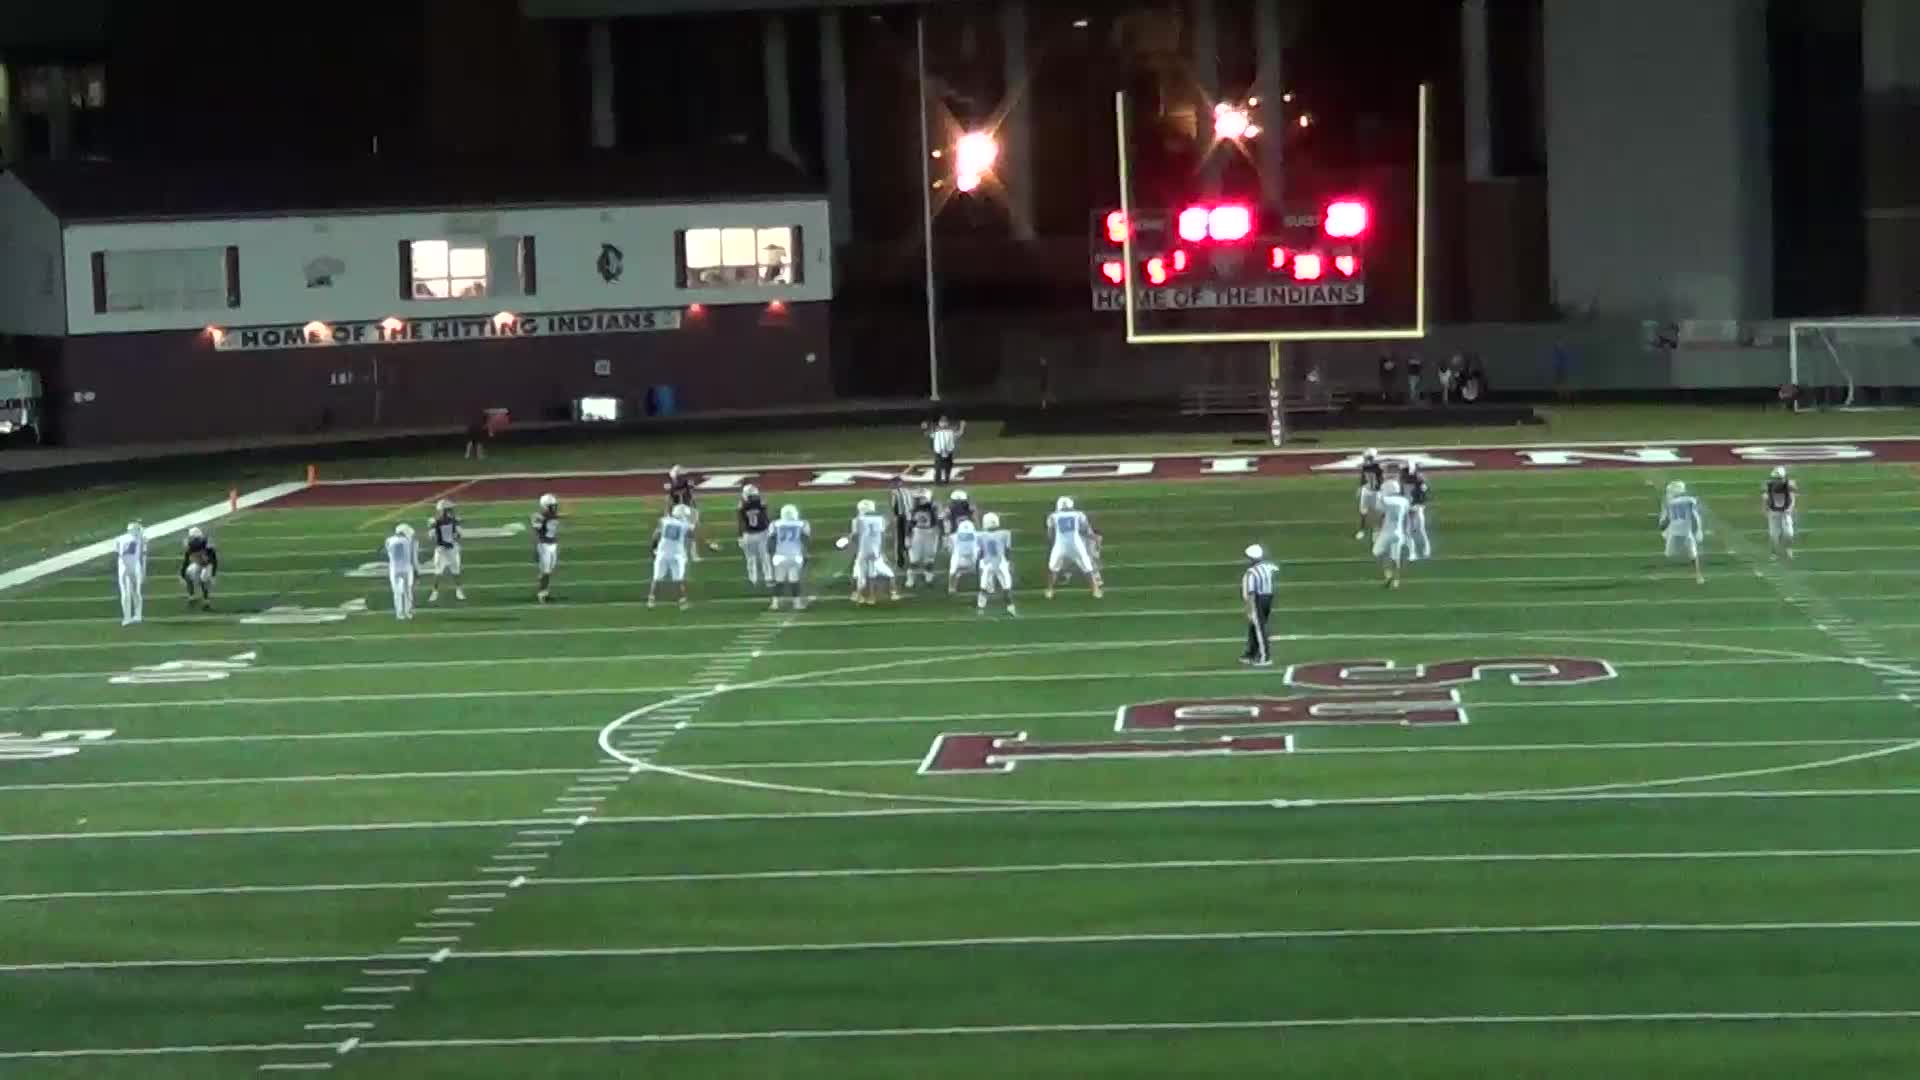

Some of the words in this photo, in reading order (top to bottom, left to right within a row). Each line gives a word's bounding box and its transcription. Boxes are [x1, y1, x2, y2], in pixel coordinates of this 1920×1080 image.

[1263, 286, 1359, 304] INDIANS
[241, 327, 322, 347] HOME
[333, 325, 365, 342] OF
[431, 317, 538, 339] HITTING
[548, 312, 656, 333] INDIANS
